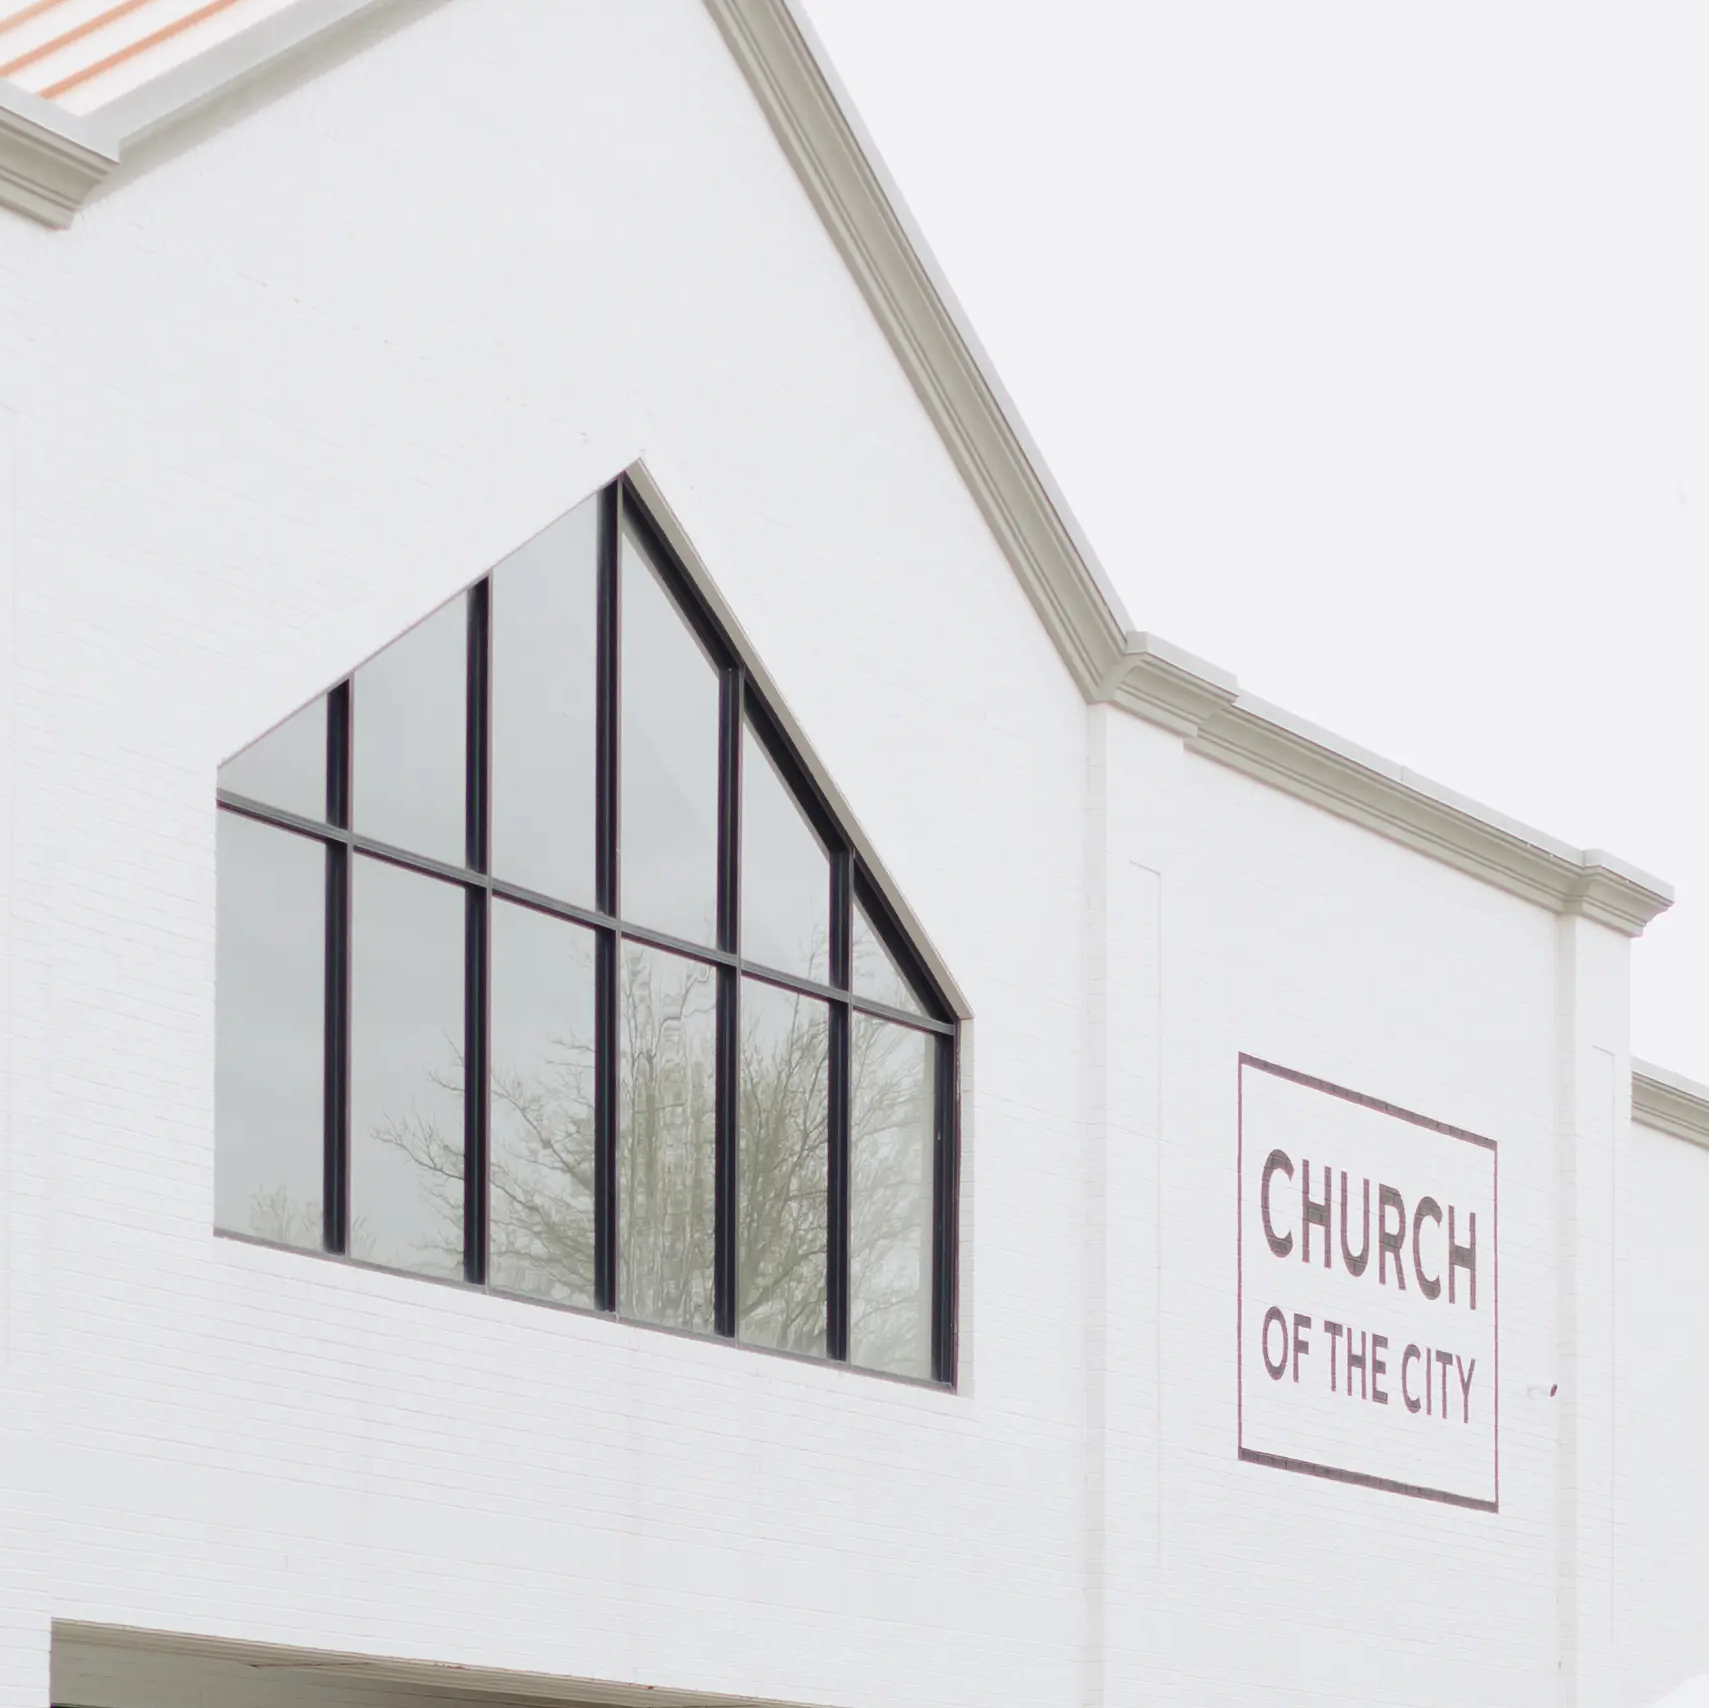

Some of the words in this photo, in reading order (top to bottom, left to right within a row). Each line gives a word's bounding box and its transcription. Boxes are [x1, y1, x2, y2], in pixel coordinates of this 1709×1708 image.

[1260, 1148, 1477, 1311] CHURCH
[1261, 1305, 1312, 1384] OF
[1323, 1319, 1389, 1406] THE
[1401, 1343, 1477, 1425] CITY
